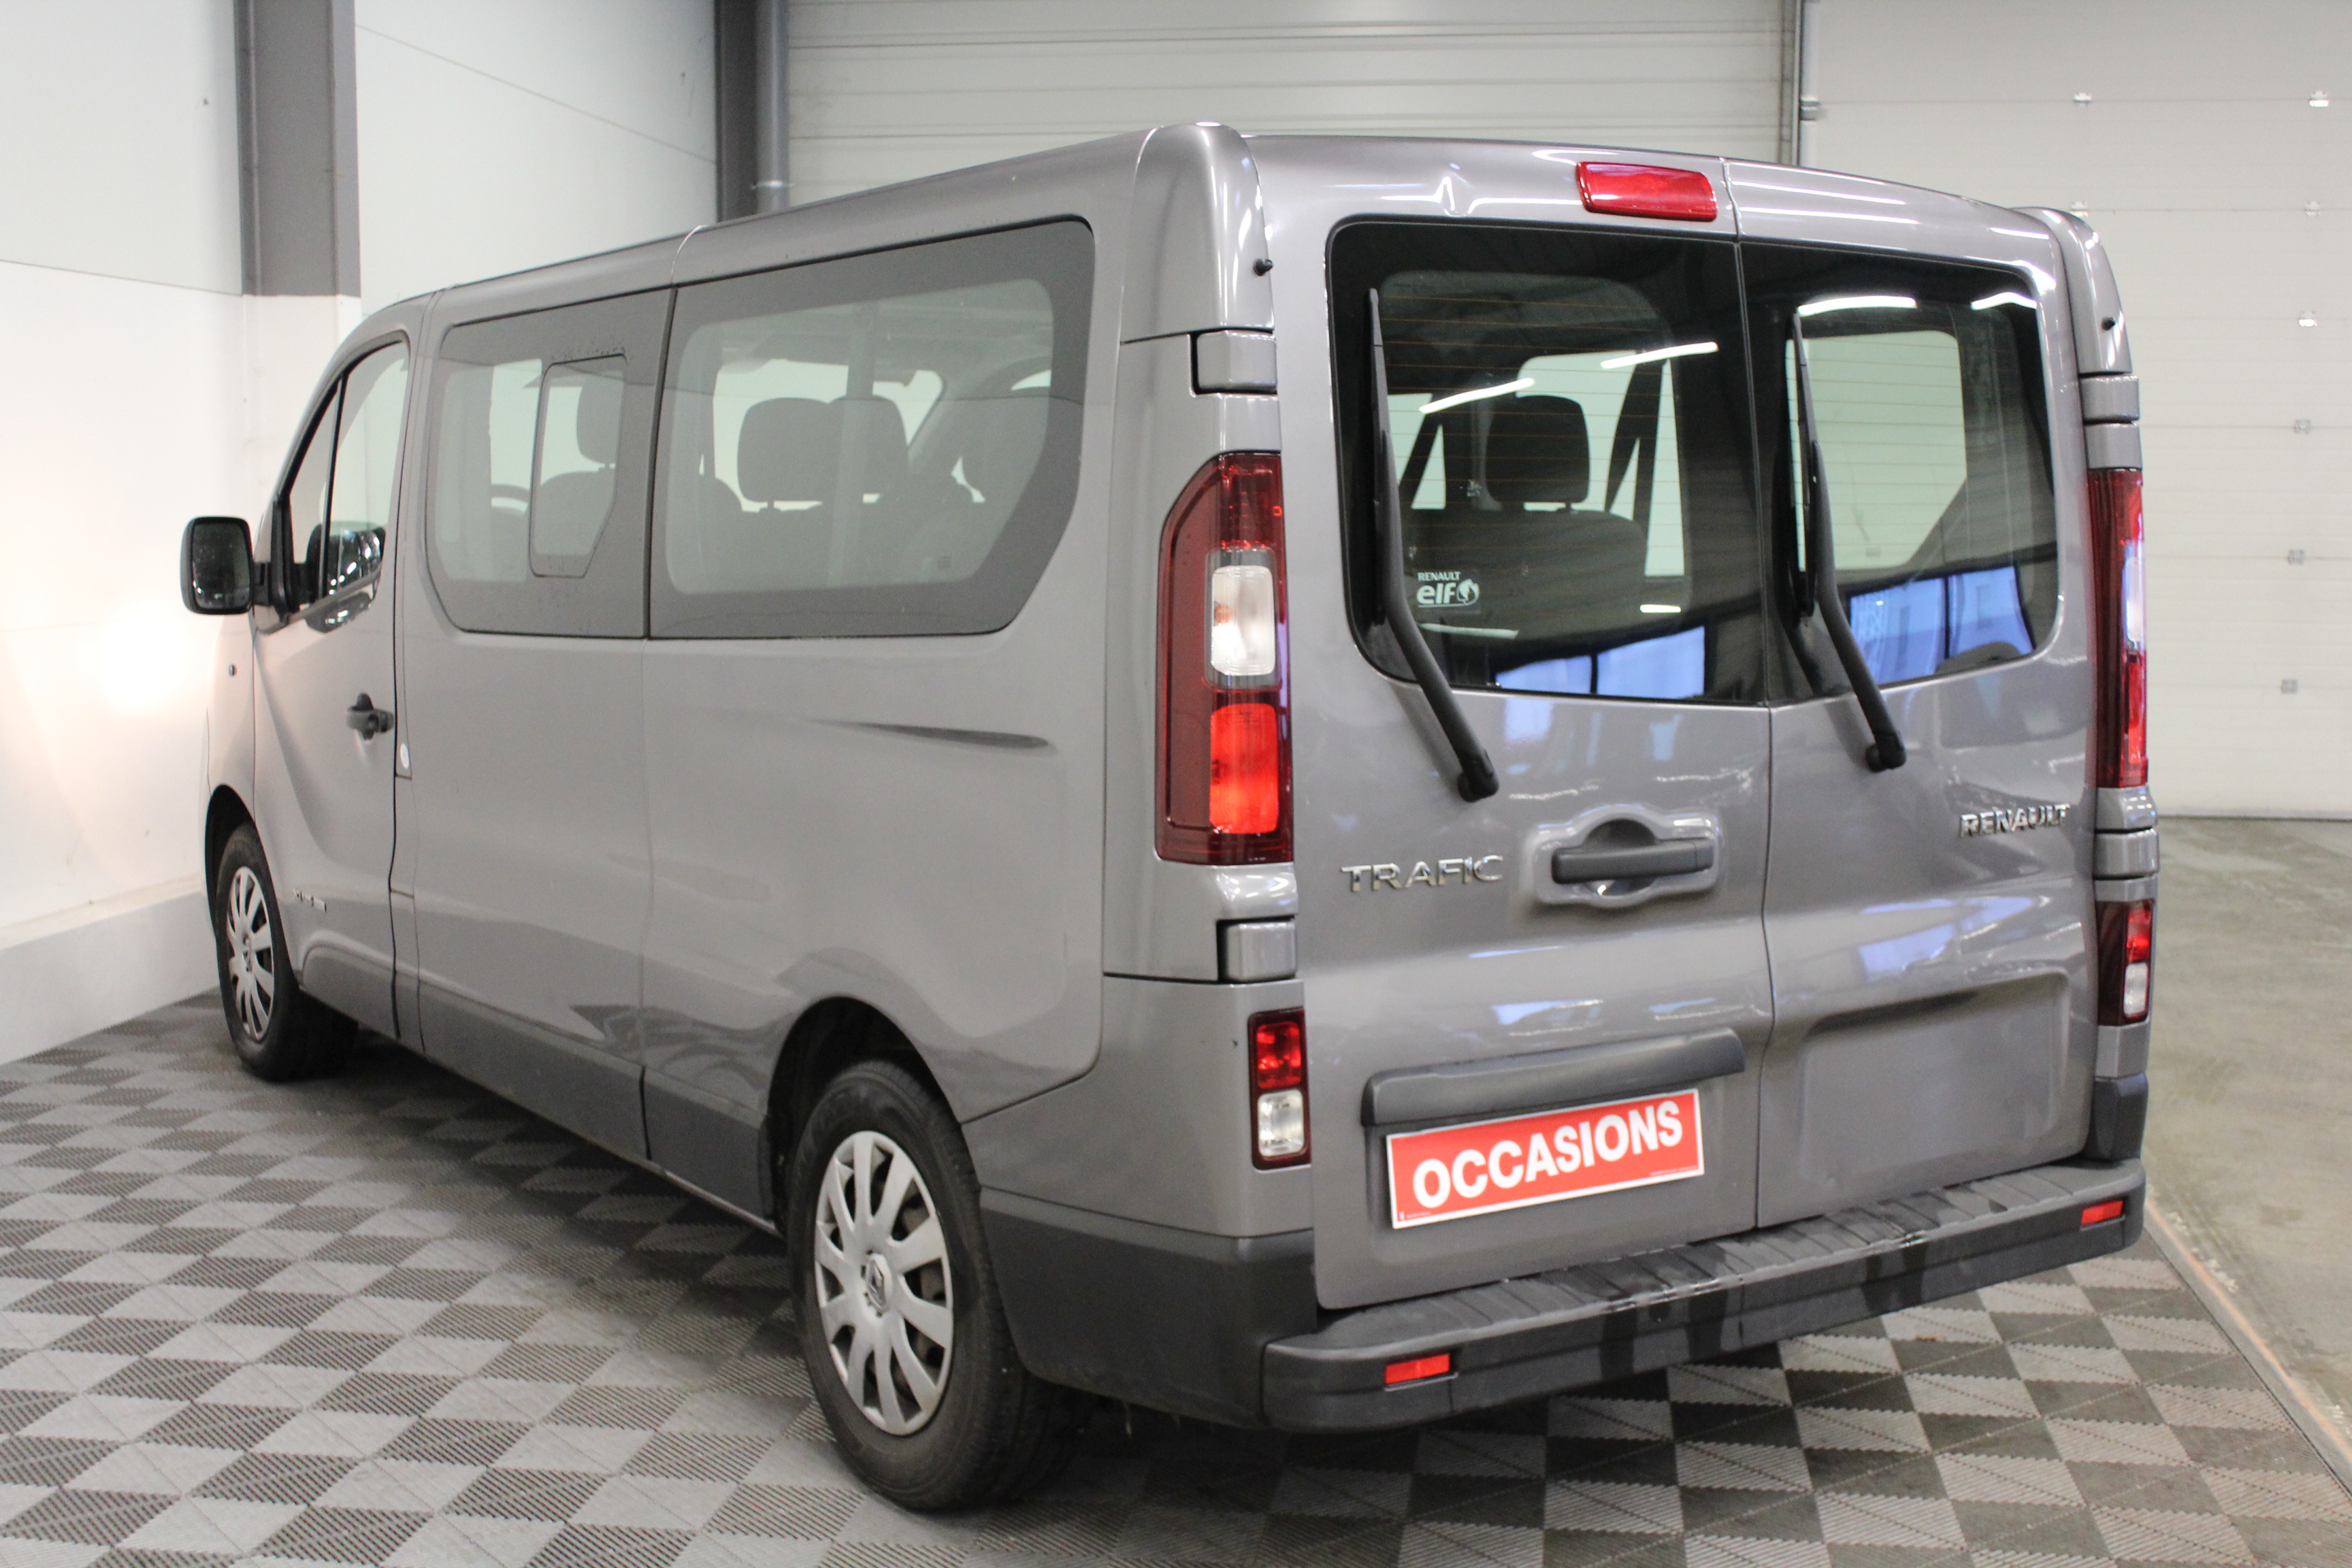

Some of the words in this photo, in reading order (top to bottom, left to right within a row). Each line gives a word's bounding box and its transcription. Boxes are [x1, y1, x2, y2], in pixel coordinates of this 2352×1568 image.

[1416, 582, 1456, 604] elf
[1417, 571, 1461, 581] RENAULT
[1960, 804, 2070, 838] RENAULT
[1341, 855, 1503, 892] TRAFIC
[1413, 1100, 1683, 1208] OCCASIONS
